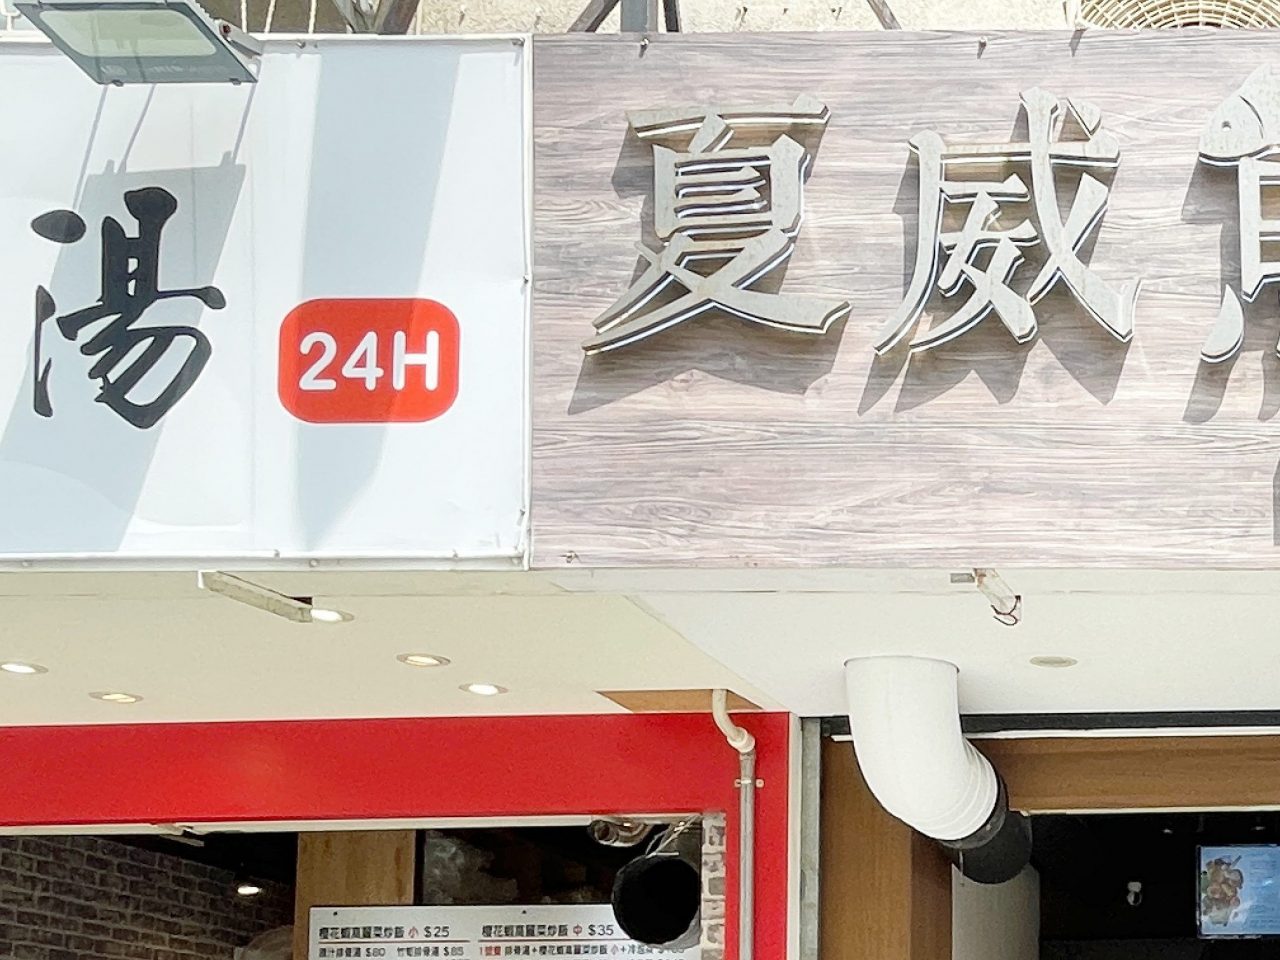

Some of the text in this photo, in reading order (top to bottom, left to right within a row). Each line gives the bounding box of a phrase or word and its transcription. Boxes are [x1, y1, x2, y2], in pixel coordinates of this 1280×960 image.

[31, 186, 226, 429] 湯
[299, 331, 440, 393] 24H
[424, 926, 450, 938] $25
[588, 924, 614, 936] $35
